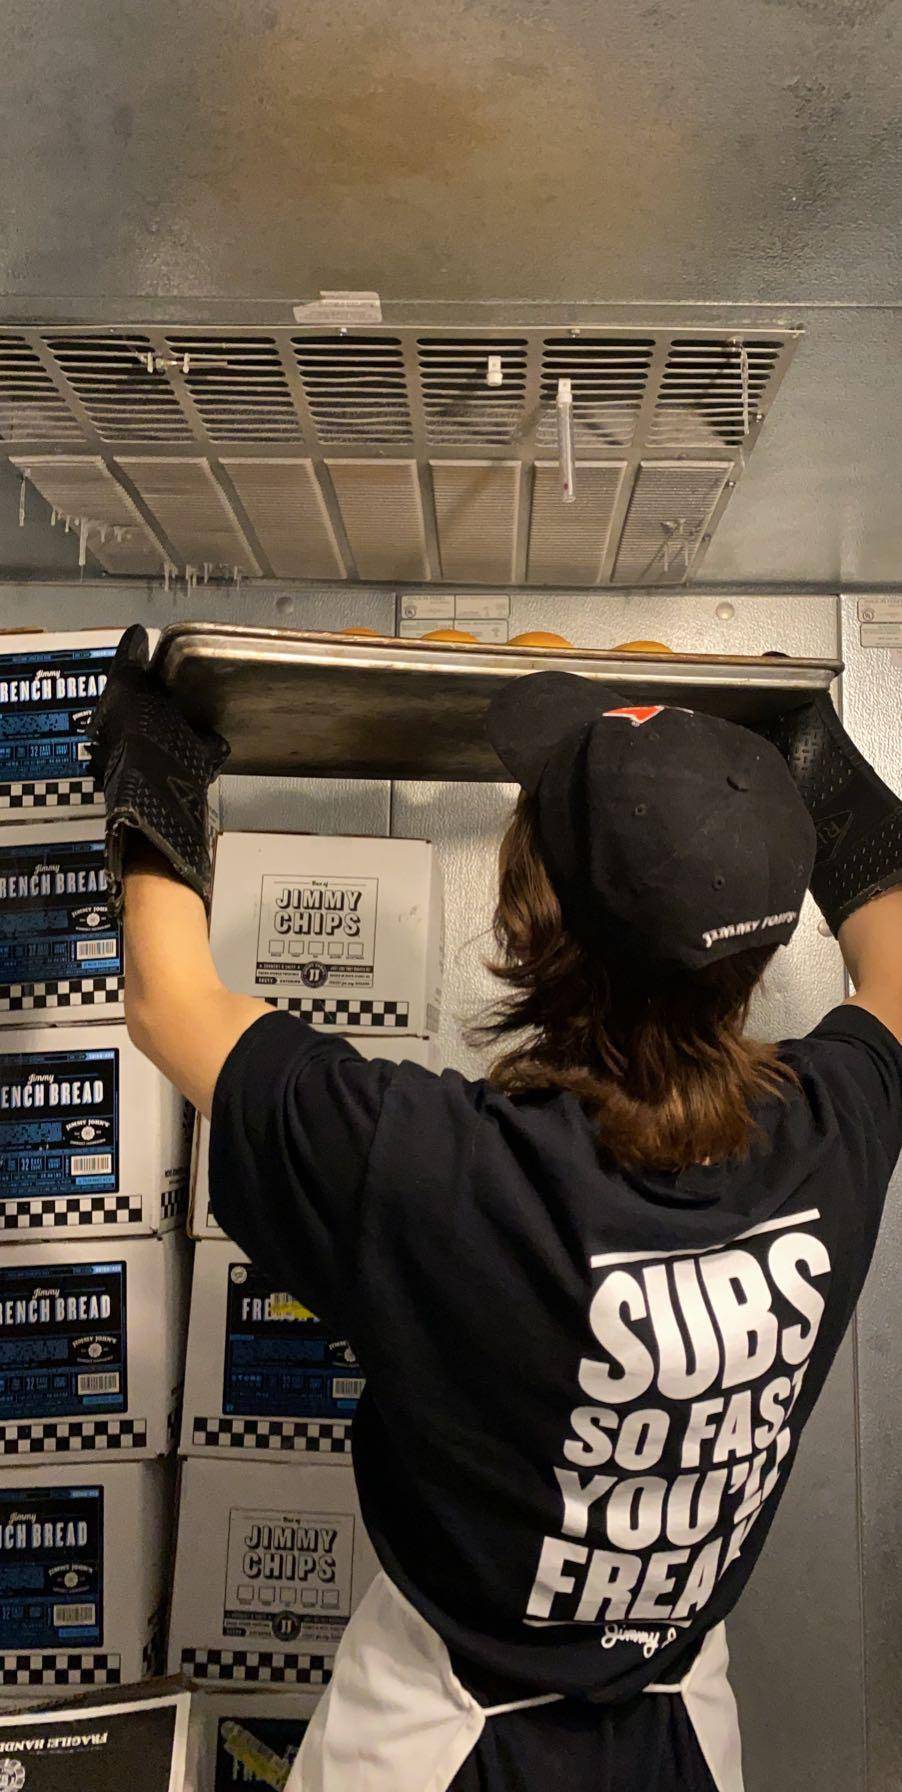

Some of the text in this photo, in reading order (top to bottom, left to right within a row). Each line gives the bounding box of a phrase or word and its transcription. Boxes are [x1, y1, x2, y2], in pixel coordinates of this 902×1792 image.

[275, 887, 362, 912] JIMMY
[274, 911, 361, 937] CHIPS
[702, 919, 760, 948] JIMMY
[28, 1073, 54, 1085] Jimmy
[51, 1079, 104, 1105] BREAD
[65, 1119, 87, 1131] JIMMY
[32, 1287, 60, 1299] Jimmy
[55, 1294, 111, 1321] BREAD
[578, 1232, 831, 1404] SUBS
[563, 1358, 810, 1471] SO FAST
[32, 1520, 88, 1549] BREAD
[244, 1525, 338, 1553] JIMMY
[242, 1551, 336, 1583] CHIPS
[601, 1624, 660, 1659] Jimmy
